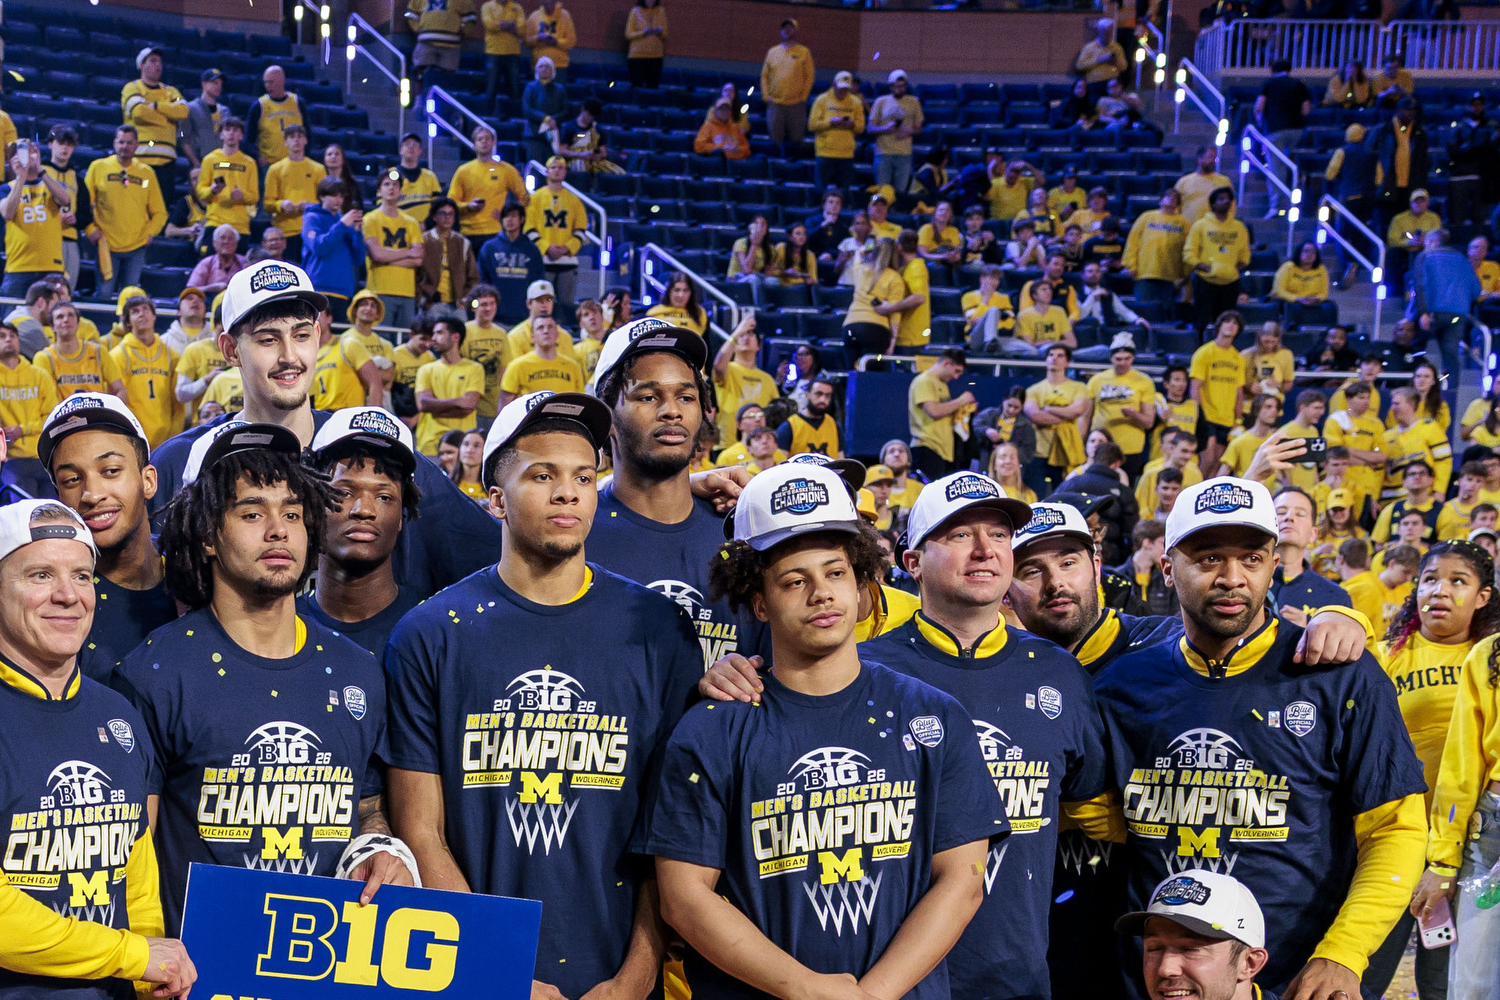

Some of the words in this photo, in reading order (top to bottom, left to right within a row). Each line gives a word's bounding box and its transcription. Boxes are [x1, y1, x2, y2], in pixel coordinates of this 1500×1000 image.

[23, 202, 47, 223] 25
[543, 209, 568, 229] M
[382, 226, 407, 248] M
[253, 274, 297, 290] CHAMPIONS
[528, 369, 571, 382] MICHIGAN
[147, 379, 156, 399] 1
[352, 419, 398, 440] CHAMPIONS
[774, 490, 827, 511] CHAMPIONS
[949, 483, 999, 499] CHAMPIONS
[1197, 495, 1251, 511] CHAMPIONS
[698, 608, 713, 621] 26
[493, 699, 512, 712] 20
[576, 700, 597, 714] 26
[1288, 705, 1313, 718] Blue
[465, 712, 516, 730] MEN'S
[520, 712, 628, 734] BASKETBALL
[231, 753, 251, 767] 20
[315, 751, 332, 766] 26
[462, 729, 629, 774] CHAMPIONS
[1005, 747, 1023, 761] 26
[987, 760, 1050, 778] KETBALL
[1155, 756, 1171, 769] 20
[1234, 758, 1254, 770] 26
[202, 767, 257, 784] MEN'S
[261, 766, 354, 784] BASKETBALL
[466, 773, 510, 784] MICHIGAN
[575, 775, 621, 786] WOLVERINES
[777, 781, 797, 797] 20
[867, 768, 887, 783] 26
[1129, 767, 1175, 785] MEN'S
[1179, 768, 1289, 791] BASKETBALL
[519, 771, 564, 805] M
[39, 795, 56, 810] 20
[110, 789, 126, 803] 26
[197, 783, 355, 826] CHAMPIONS
[751, 794, 804, 819] MEN'S
[810, 780, 917, 809] BASKETBALL
[1122, 783, 1291, 826] CHAMPIONS
[10, 809, 62, 832] MEN'S
[751, 798, 917, 862] CHAMPIONS
[200, 827, 251, 838] MICHIGAN
[314, 829, 349, 838] WOLVERINES
[1177, 825, 1222, 858] M
[1235, 829, 1285, 838] WOLVERINES
[260, 826, 304, 861] M
[762, 857, 807, 874] MICHIGAN
[817, 847, 865, 886] M
[7, 875, 59, 886] MICHIGAN
[66, 869, 111, 908] M
[1155, 888, 1206, 903] CHAMPIONS
